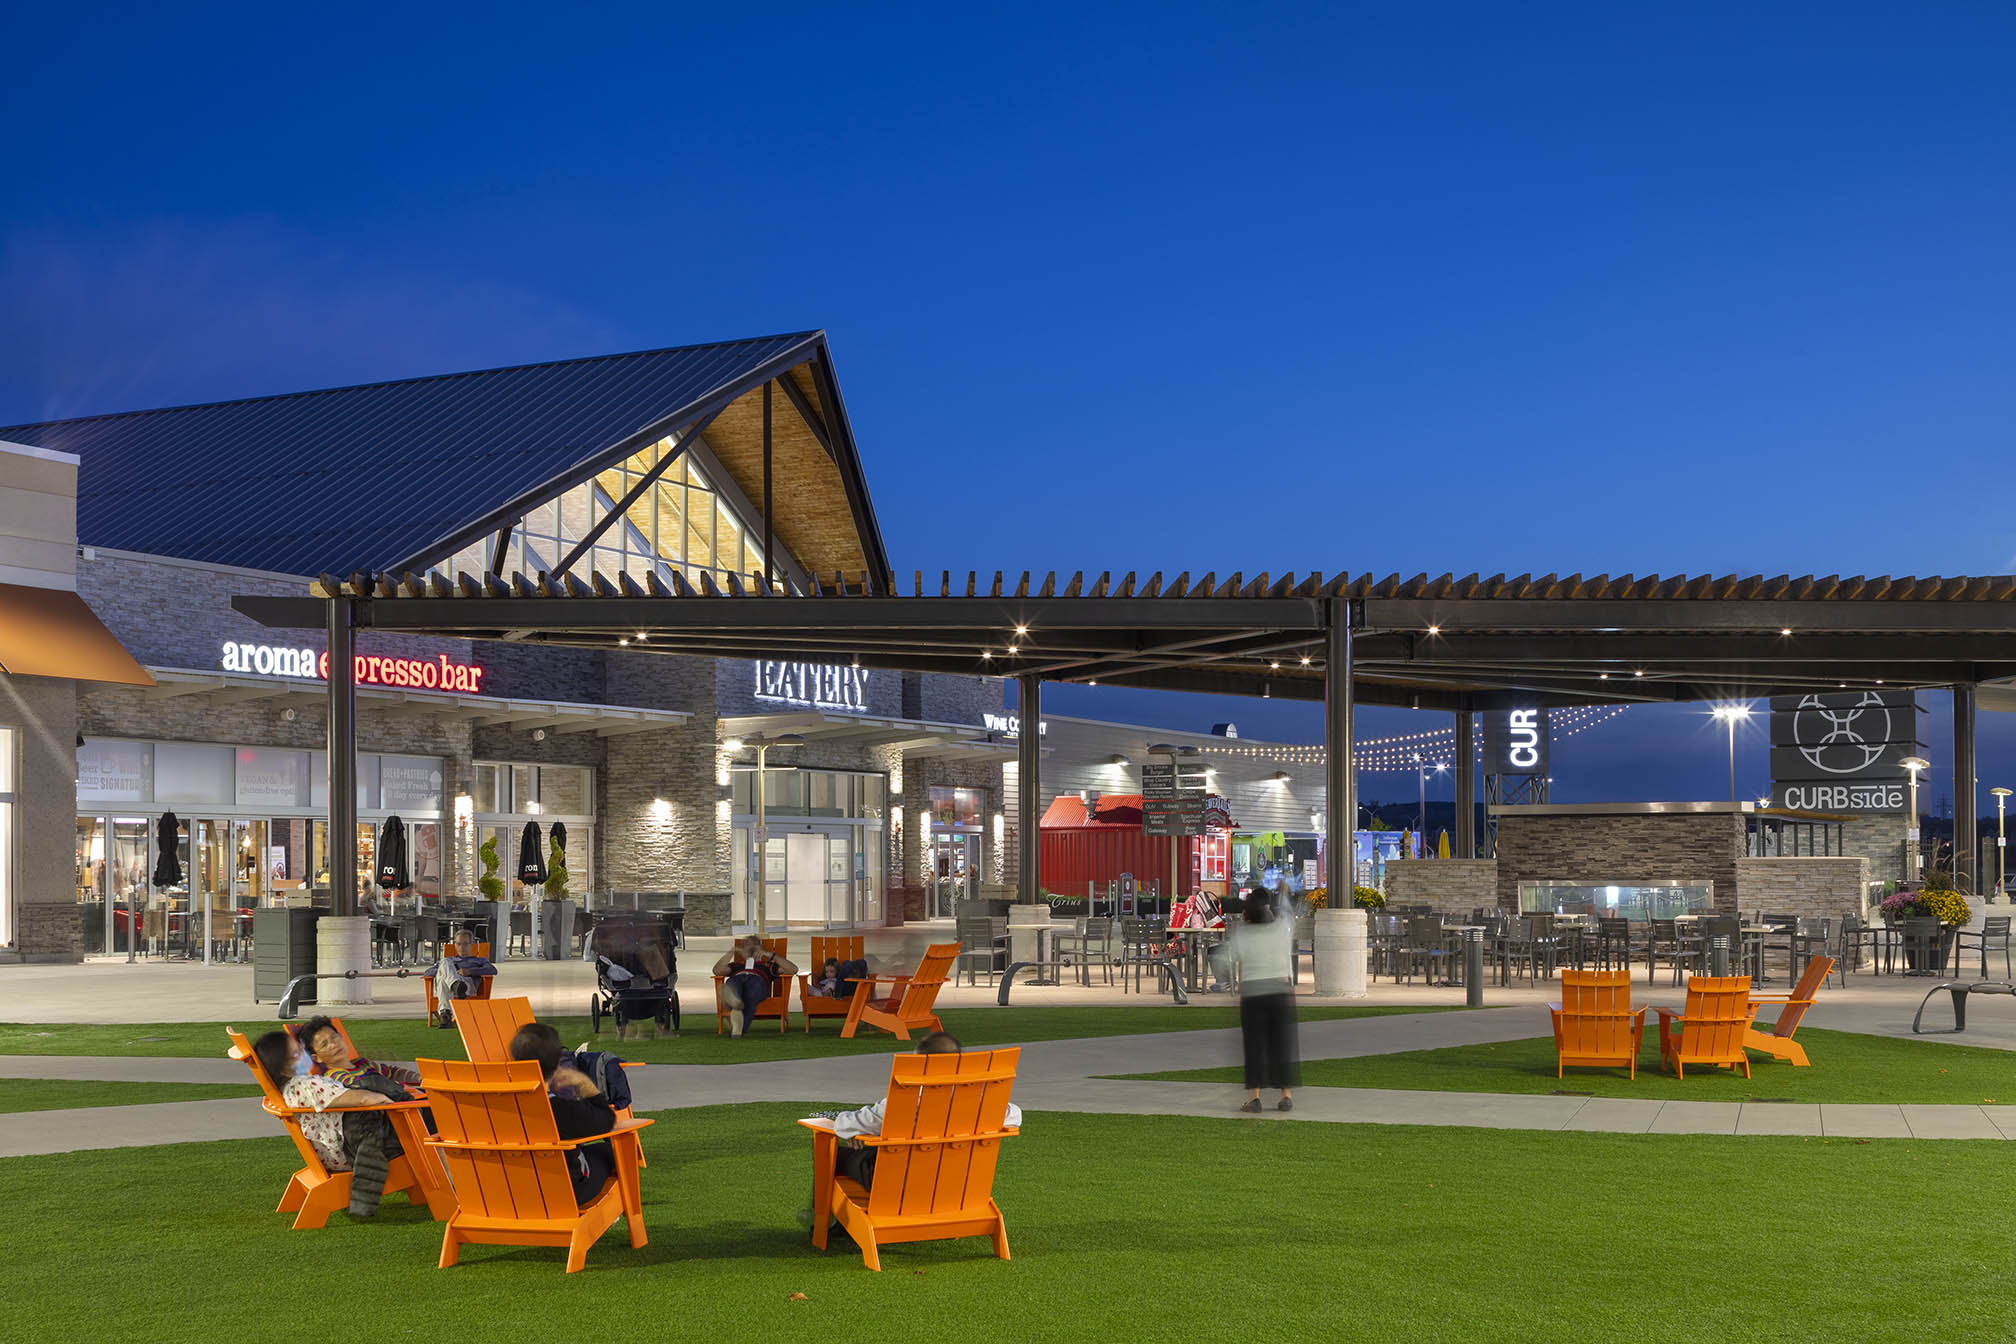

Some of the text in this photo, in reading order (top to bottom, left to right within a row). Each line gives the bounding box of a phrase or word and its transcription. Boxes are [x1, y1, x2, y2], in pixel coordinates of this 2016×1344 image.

[222, 641, 482, 693] aroma epresso bar
[1784, 784, 1904, 810] CURBside
